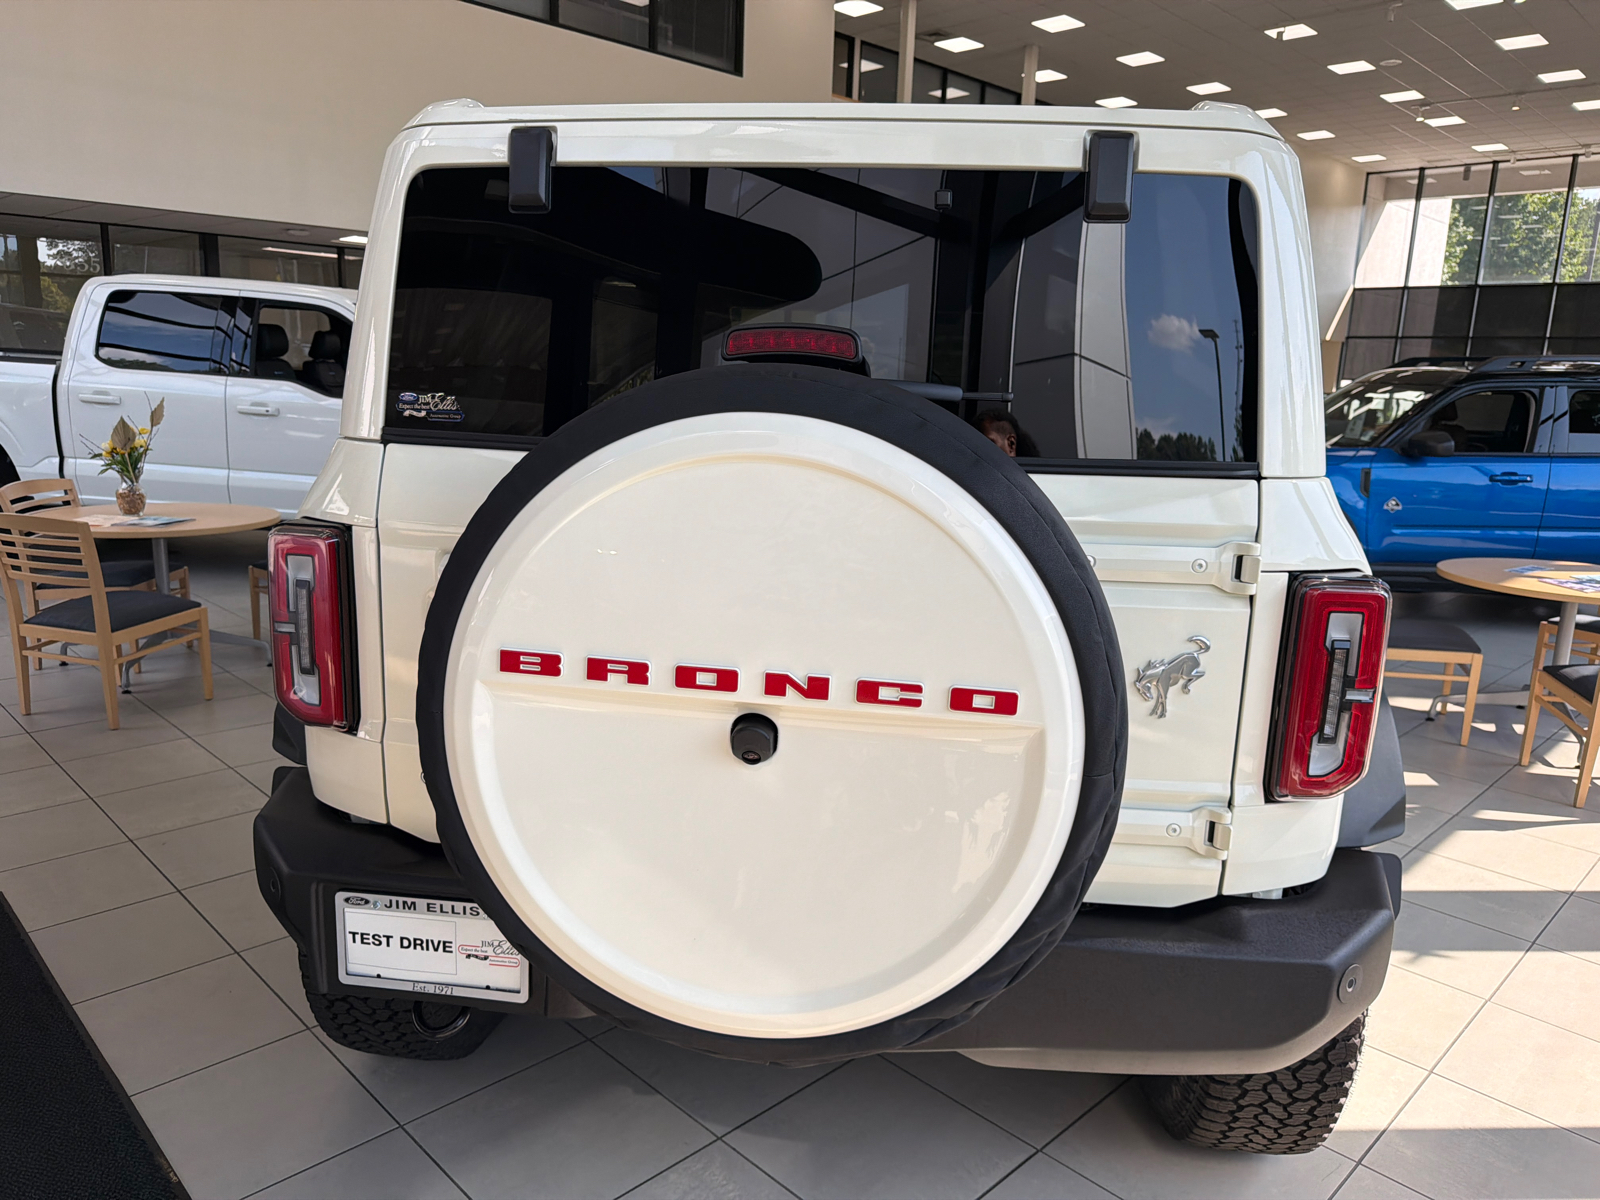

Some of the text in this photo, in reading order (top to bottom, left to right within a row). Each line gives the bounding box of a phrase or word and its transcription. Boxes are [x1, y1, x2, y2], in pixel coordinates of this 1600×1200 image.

[418, 393, 457, 411] JIM Ellis
[499, 647, 1021, 716] BRONCO
[384, 899, 481, 917] JIM ELLIS
[348, 931, 453, 953] TEST DRIVE
[481, 939, 520, 956] JIM Ellis
[412, 982, 454, 995] Est. 1971
